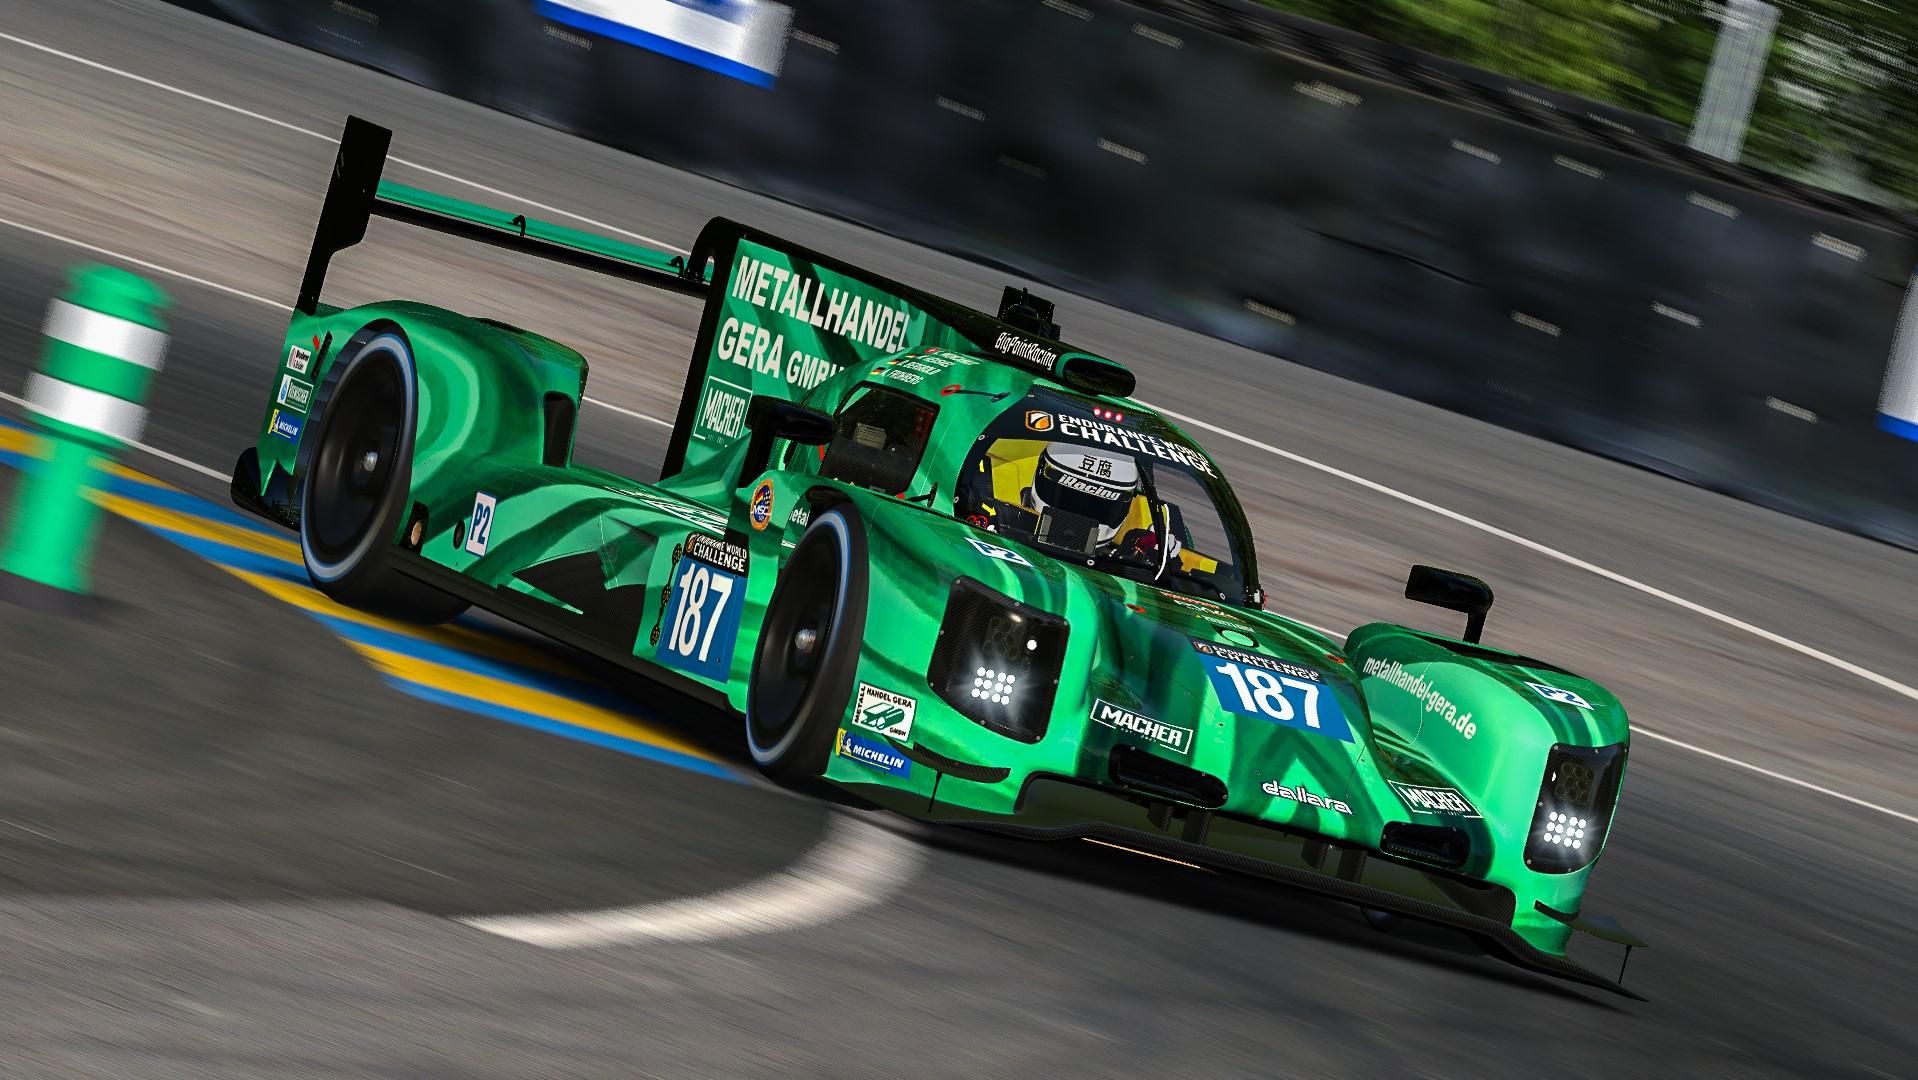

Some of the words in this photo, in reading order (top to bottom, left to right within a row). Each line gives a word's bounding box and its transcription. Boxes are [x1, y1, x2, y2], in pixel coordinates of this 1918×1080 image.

[732, 256, 910, 353] METALLHANDEL
[718, 317, 784, 379] GERA
[995, 332, 1057, 370] BigPointRacing
[701, 388, 746, 439] MACHER
[1059, 414, 1158, 445] ENDURANCE
[1160, 438, 1210, 467] WORLD
[1060, 423, 1218, 479] CHALLENGE
[1078, 455, 1112, 478] 豆腐
[1058, 473, 1121, 500] iRacing
[470, 502, 491, 545] P2
[789, 508, 810, 527] etal
[693, 542, 746, 572] CHALLENGE
[726, 543, 748, 559] WORLD
[668, 562, 734, 662] 187
[1216, 650, 1321, 682] CHALLENGE
[854, 686, 866, 723] METALL
[867, 688, 891, 702] HANDEL
[892, 696, 912, 708] GERA
[1216, 662, 1320, 729] 187
[1363, 656, 1477, 740] metallhandel-gera.de
[1101, 705, 1182, 746] MACHER
[852, 744, 905, 769] MICHELIN
[1262, 780, 1353, 815] dallara
[1398, 787, 1471, 811] MACHER
